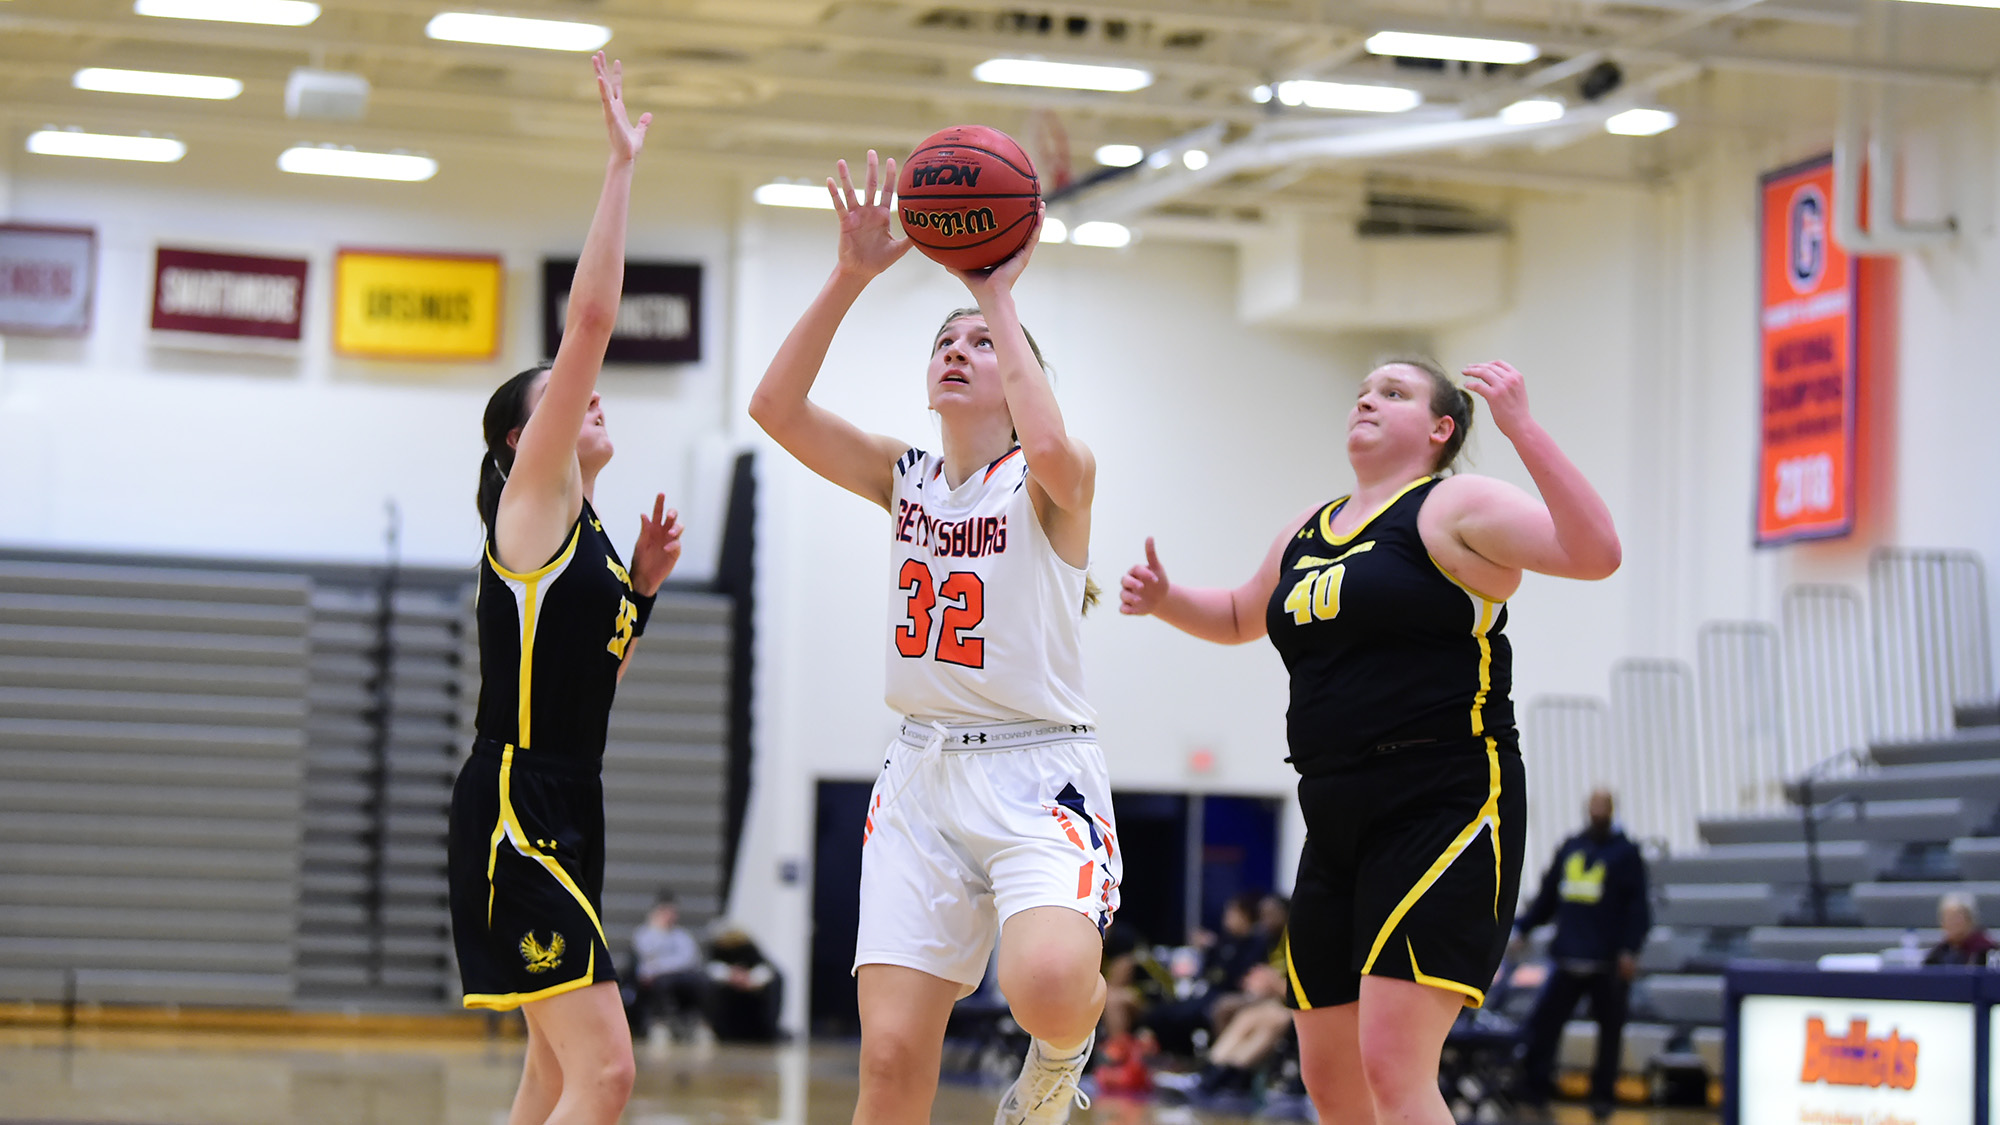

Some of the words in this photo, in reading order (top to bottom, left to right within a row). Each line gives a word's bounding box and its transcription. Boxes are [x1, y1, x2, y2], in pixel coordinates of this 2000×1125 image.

[912, 164, 982, 188] NCAA
[902, 207, 998, 237] Wilson
[895, 558, 985, 669] 32
[1284, 563, 1346, 626] 40
